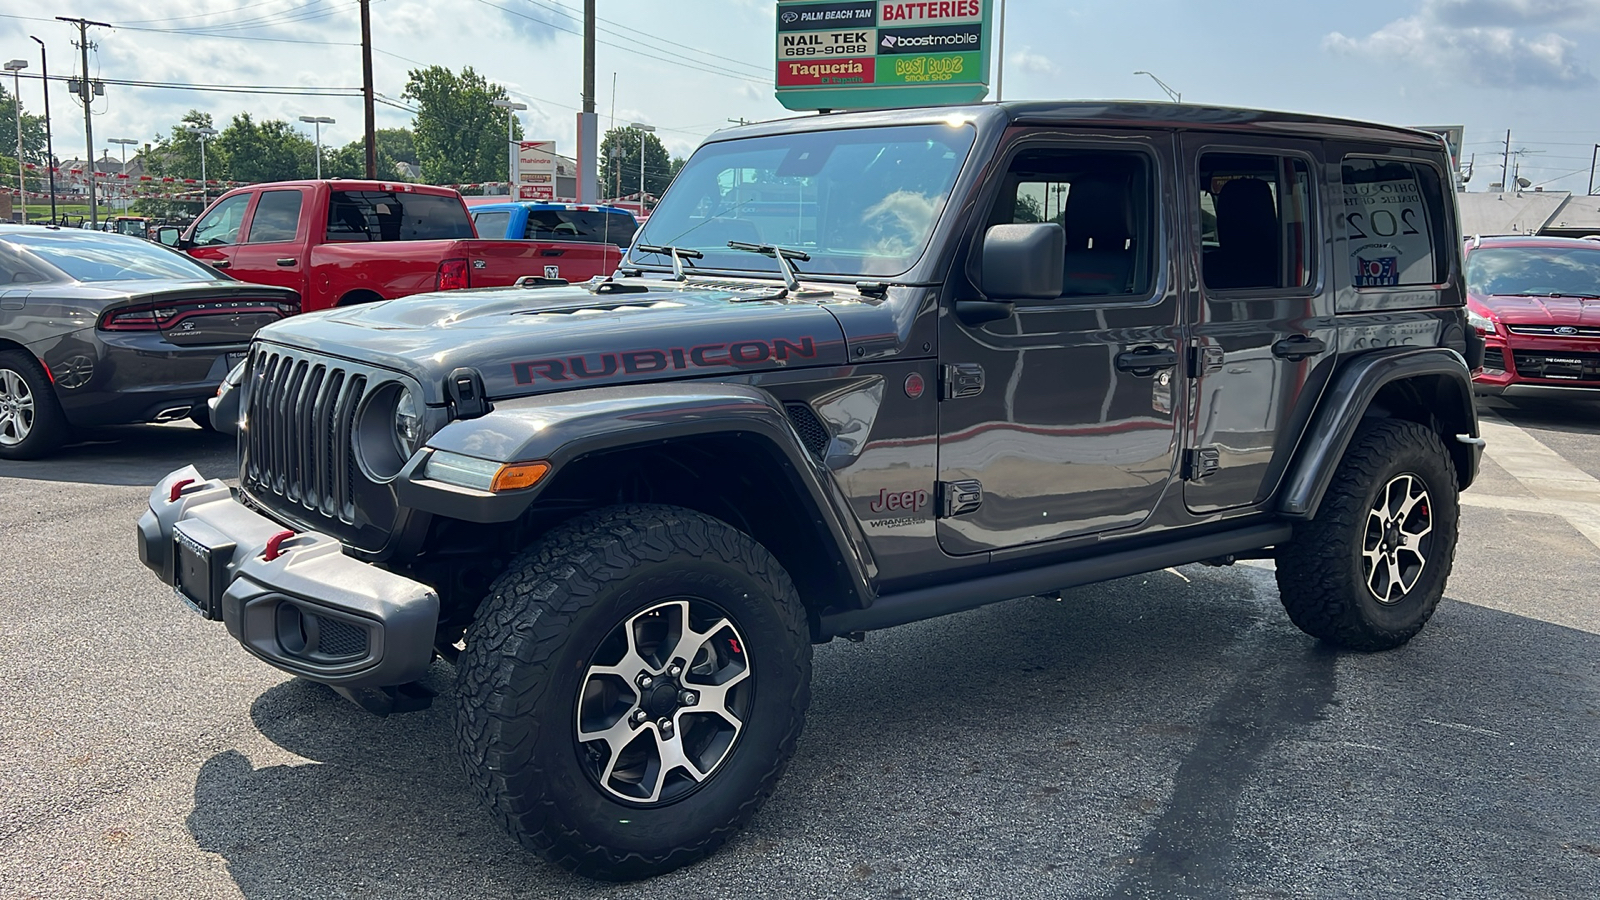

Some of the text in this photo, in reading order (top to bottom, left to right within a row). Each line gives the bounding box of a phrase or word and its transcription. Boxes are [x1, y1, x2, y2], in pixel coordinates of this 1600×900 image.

[801, 9, 872, 21] PALM BEACH TAN
[883, 0, 979, 20] BATTERIES
[784, 32, 867, 46] NAIL TEK
[785, 45, 867, 56] 689-9088
[511, 336, 818, 386] RUBICON
[870, 488, 928, 513] Jeep
[870, 516, 925, 528] WRANGLER
